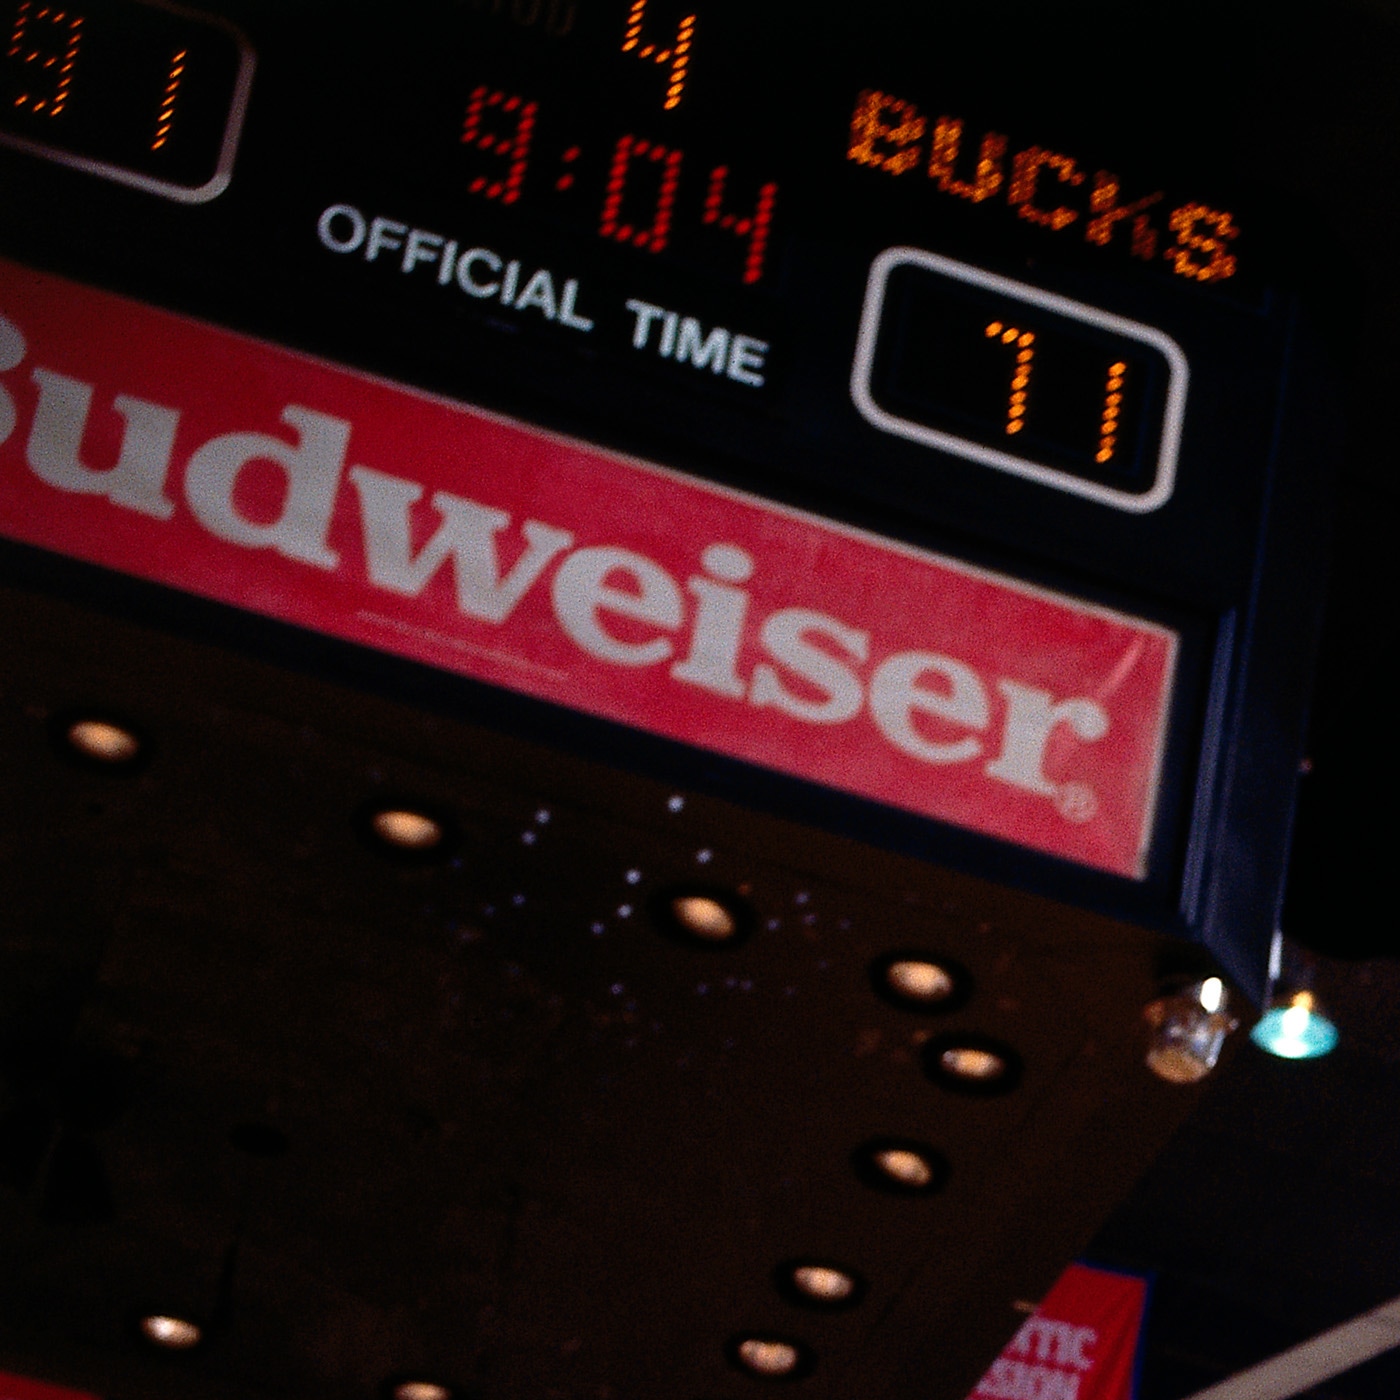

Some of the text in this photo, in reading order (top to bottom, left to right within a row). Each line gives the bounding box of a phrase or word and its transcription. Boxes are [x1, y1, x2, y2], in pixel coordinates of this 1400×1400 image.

[5, 0, 190, 153] 91
[620, 0, 698, 111] 4
[460, 85, 779, 286] 9:04
[846, 88, 1240, 283] BUCKS
[317, 203, 773, 389] OFFICIAL TIME
[983, 319, 1129, 466] 71
[0, 316, 1112, 797] udweiser
